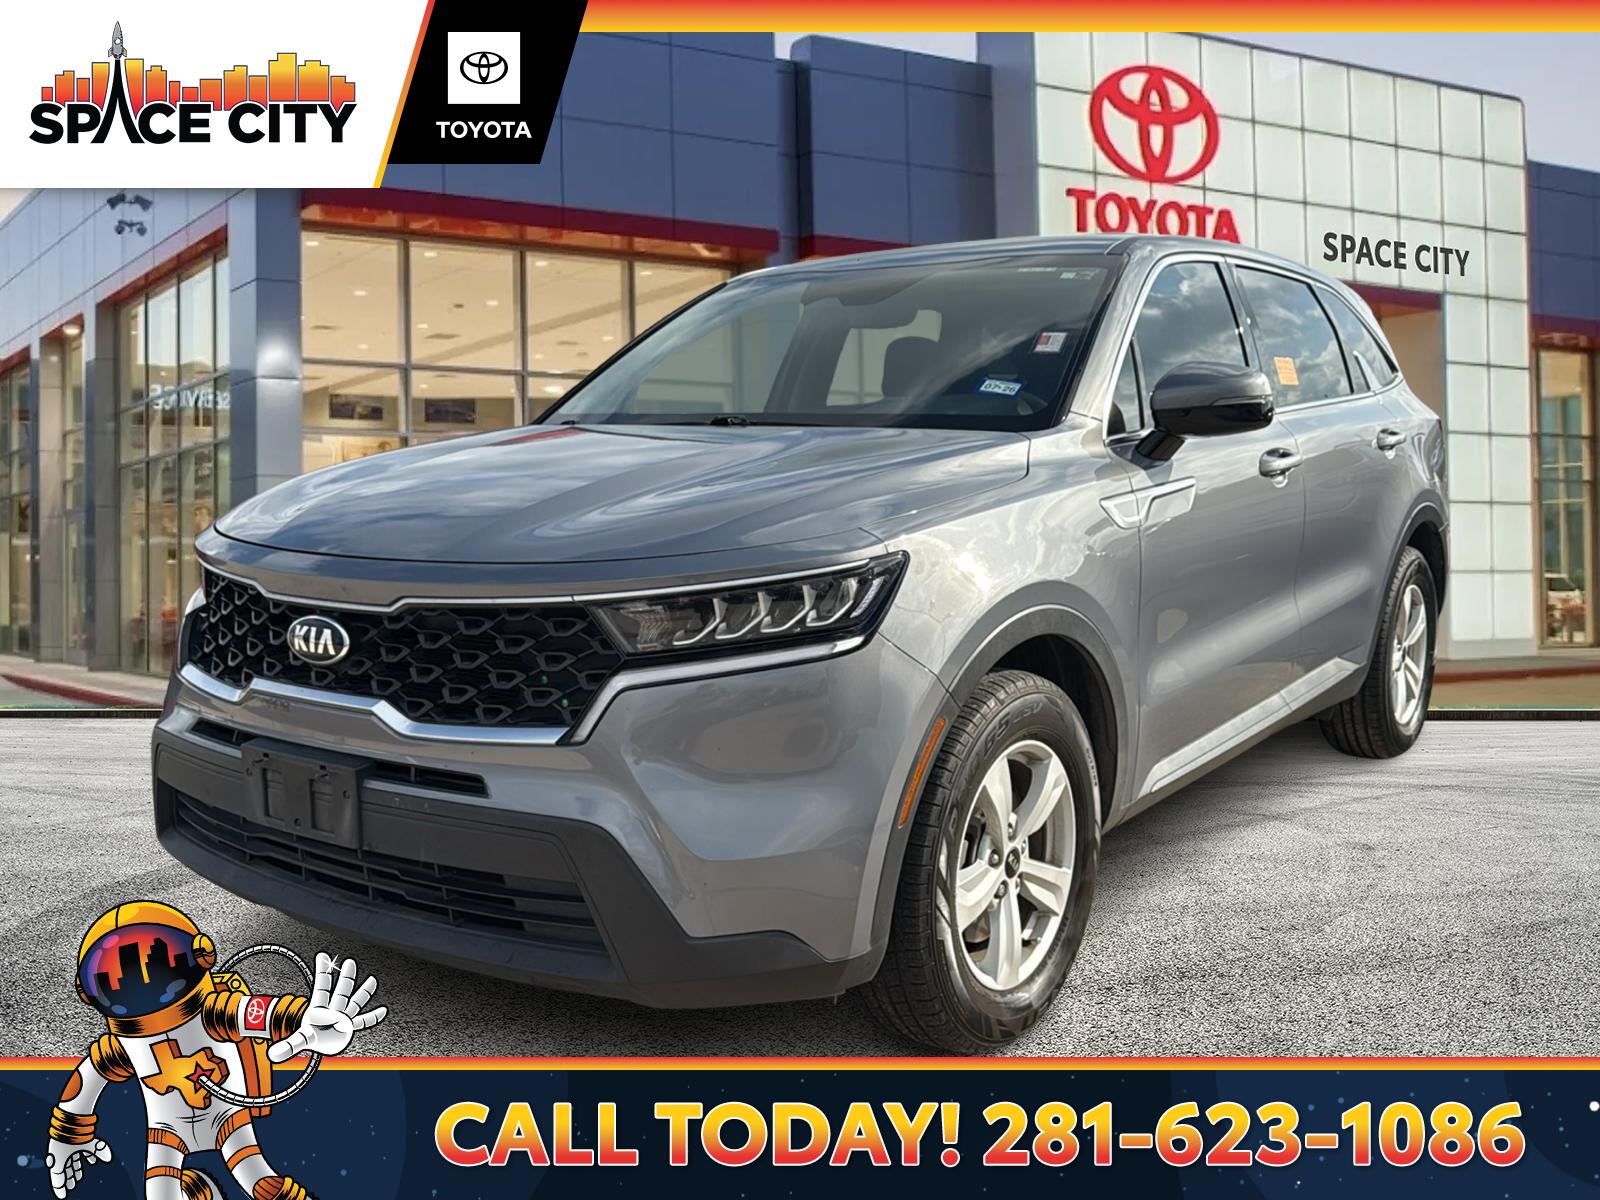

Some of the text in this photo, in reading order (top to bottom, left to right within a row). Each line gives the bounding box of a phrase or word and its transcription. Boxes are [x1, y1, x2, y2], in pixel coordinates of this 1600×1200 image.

[1066, 188, 1241, 244] TOYOTA
[1323, 232, 1470, 277] SPACE CITY
[294, 624, 336, 656] KIA
